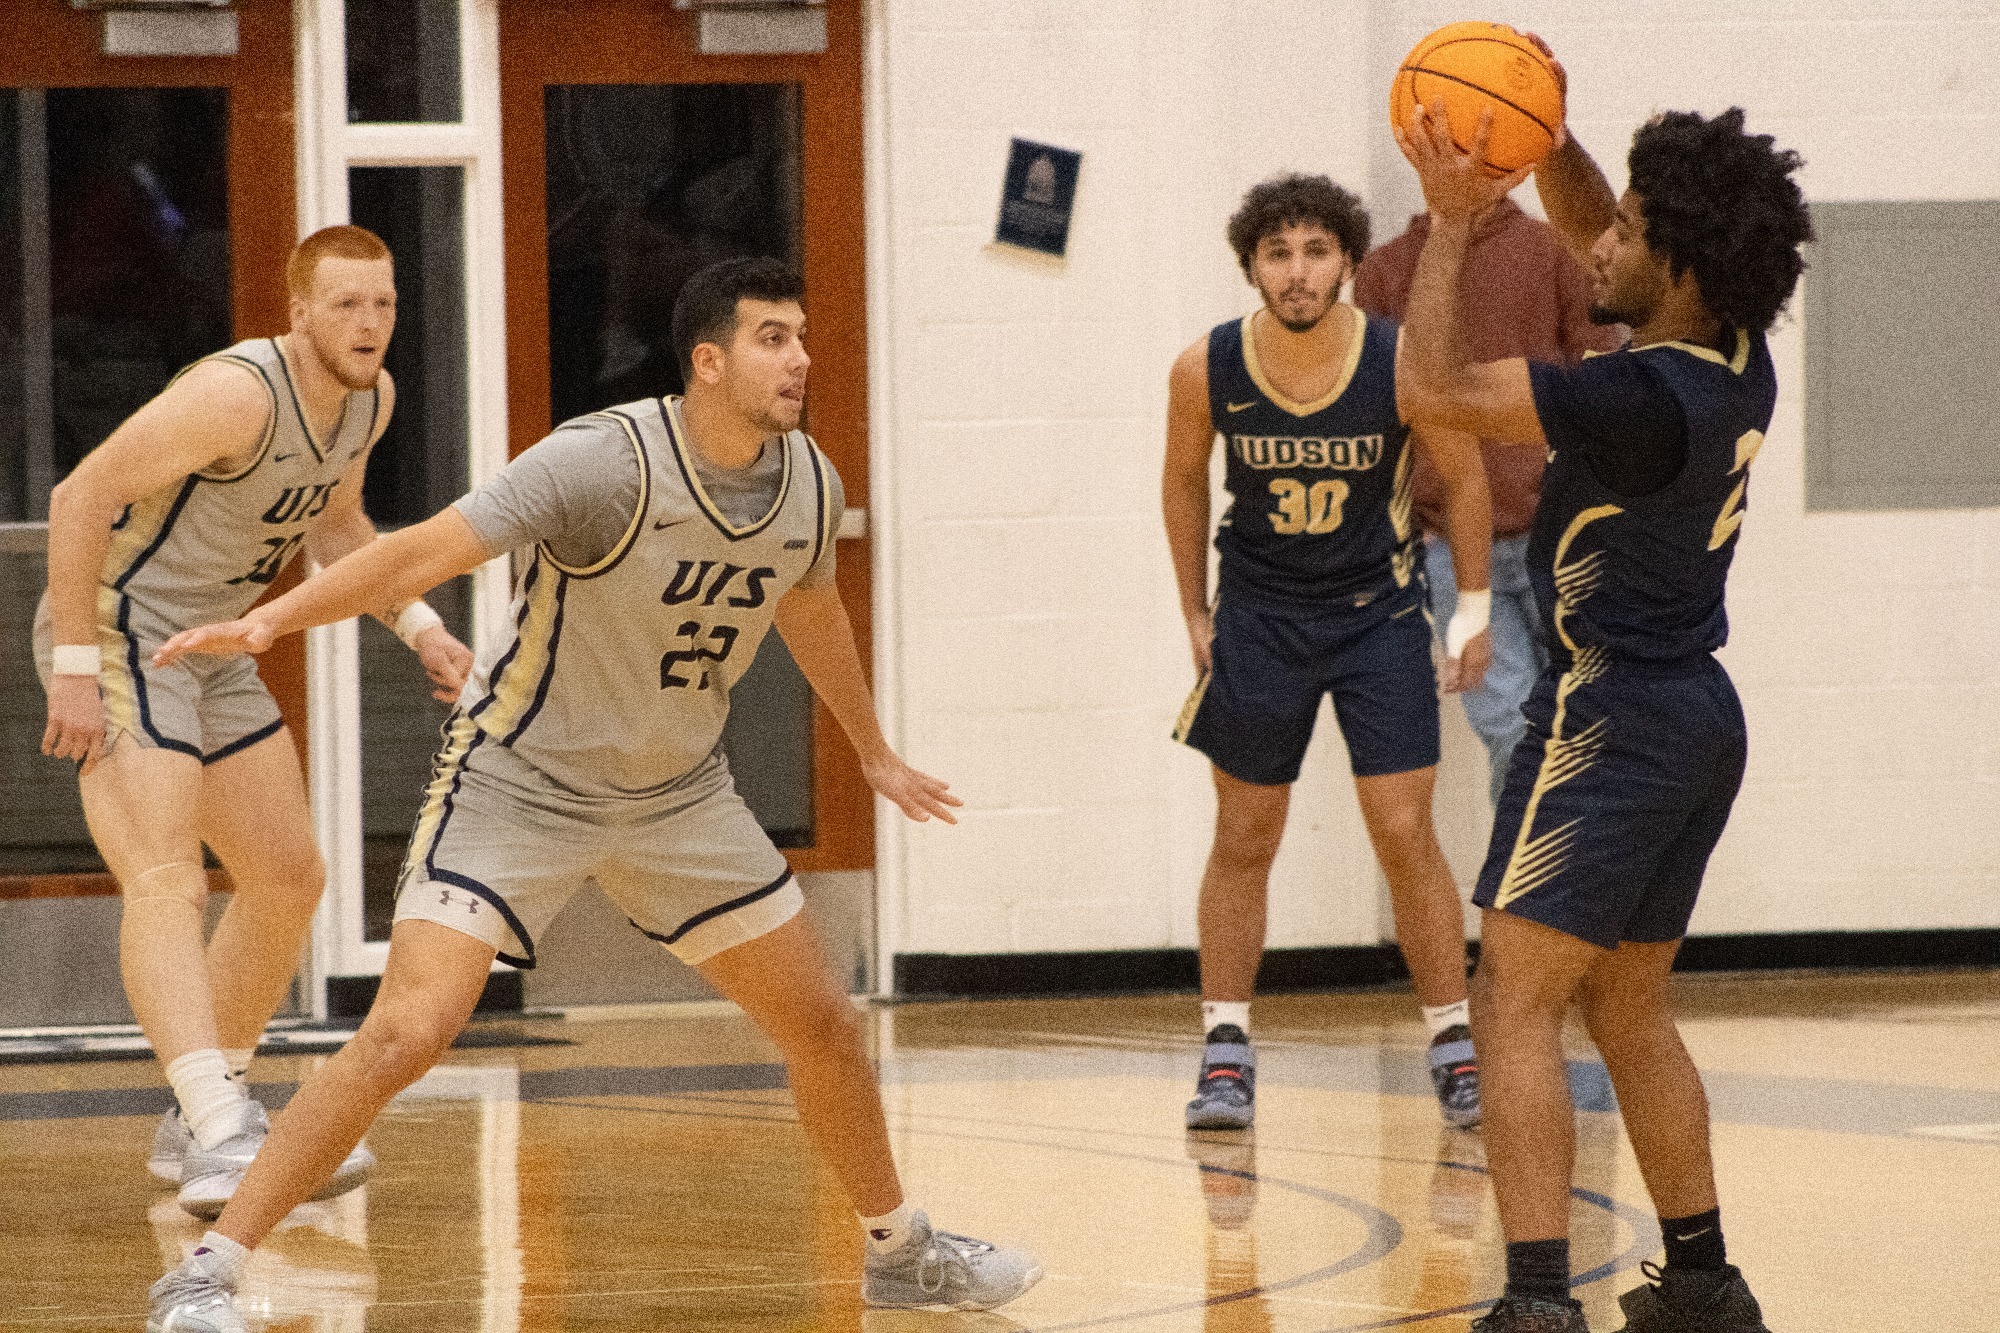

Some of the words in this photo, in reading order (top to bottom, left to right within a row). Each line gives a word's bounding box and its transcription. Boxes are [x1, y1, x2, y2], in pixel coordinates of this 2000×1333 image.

[262, 479, 340, 524] UIS
[1267, 477, 1349, 535] 30
[1707, 428, 1765, 551] 2
[661, 559, 777, 609] UIS
[660, 620, 740, 690] 22
